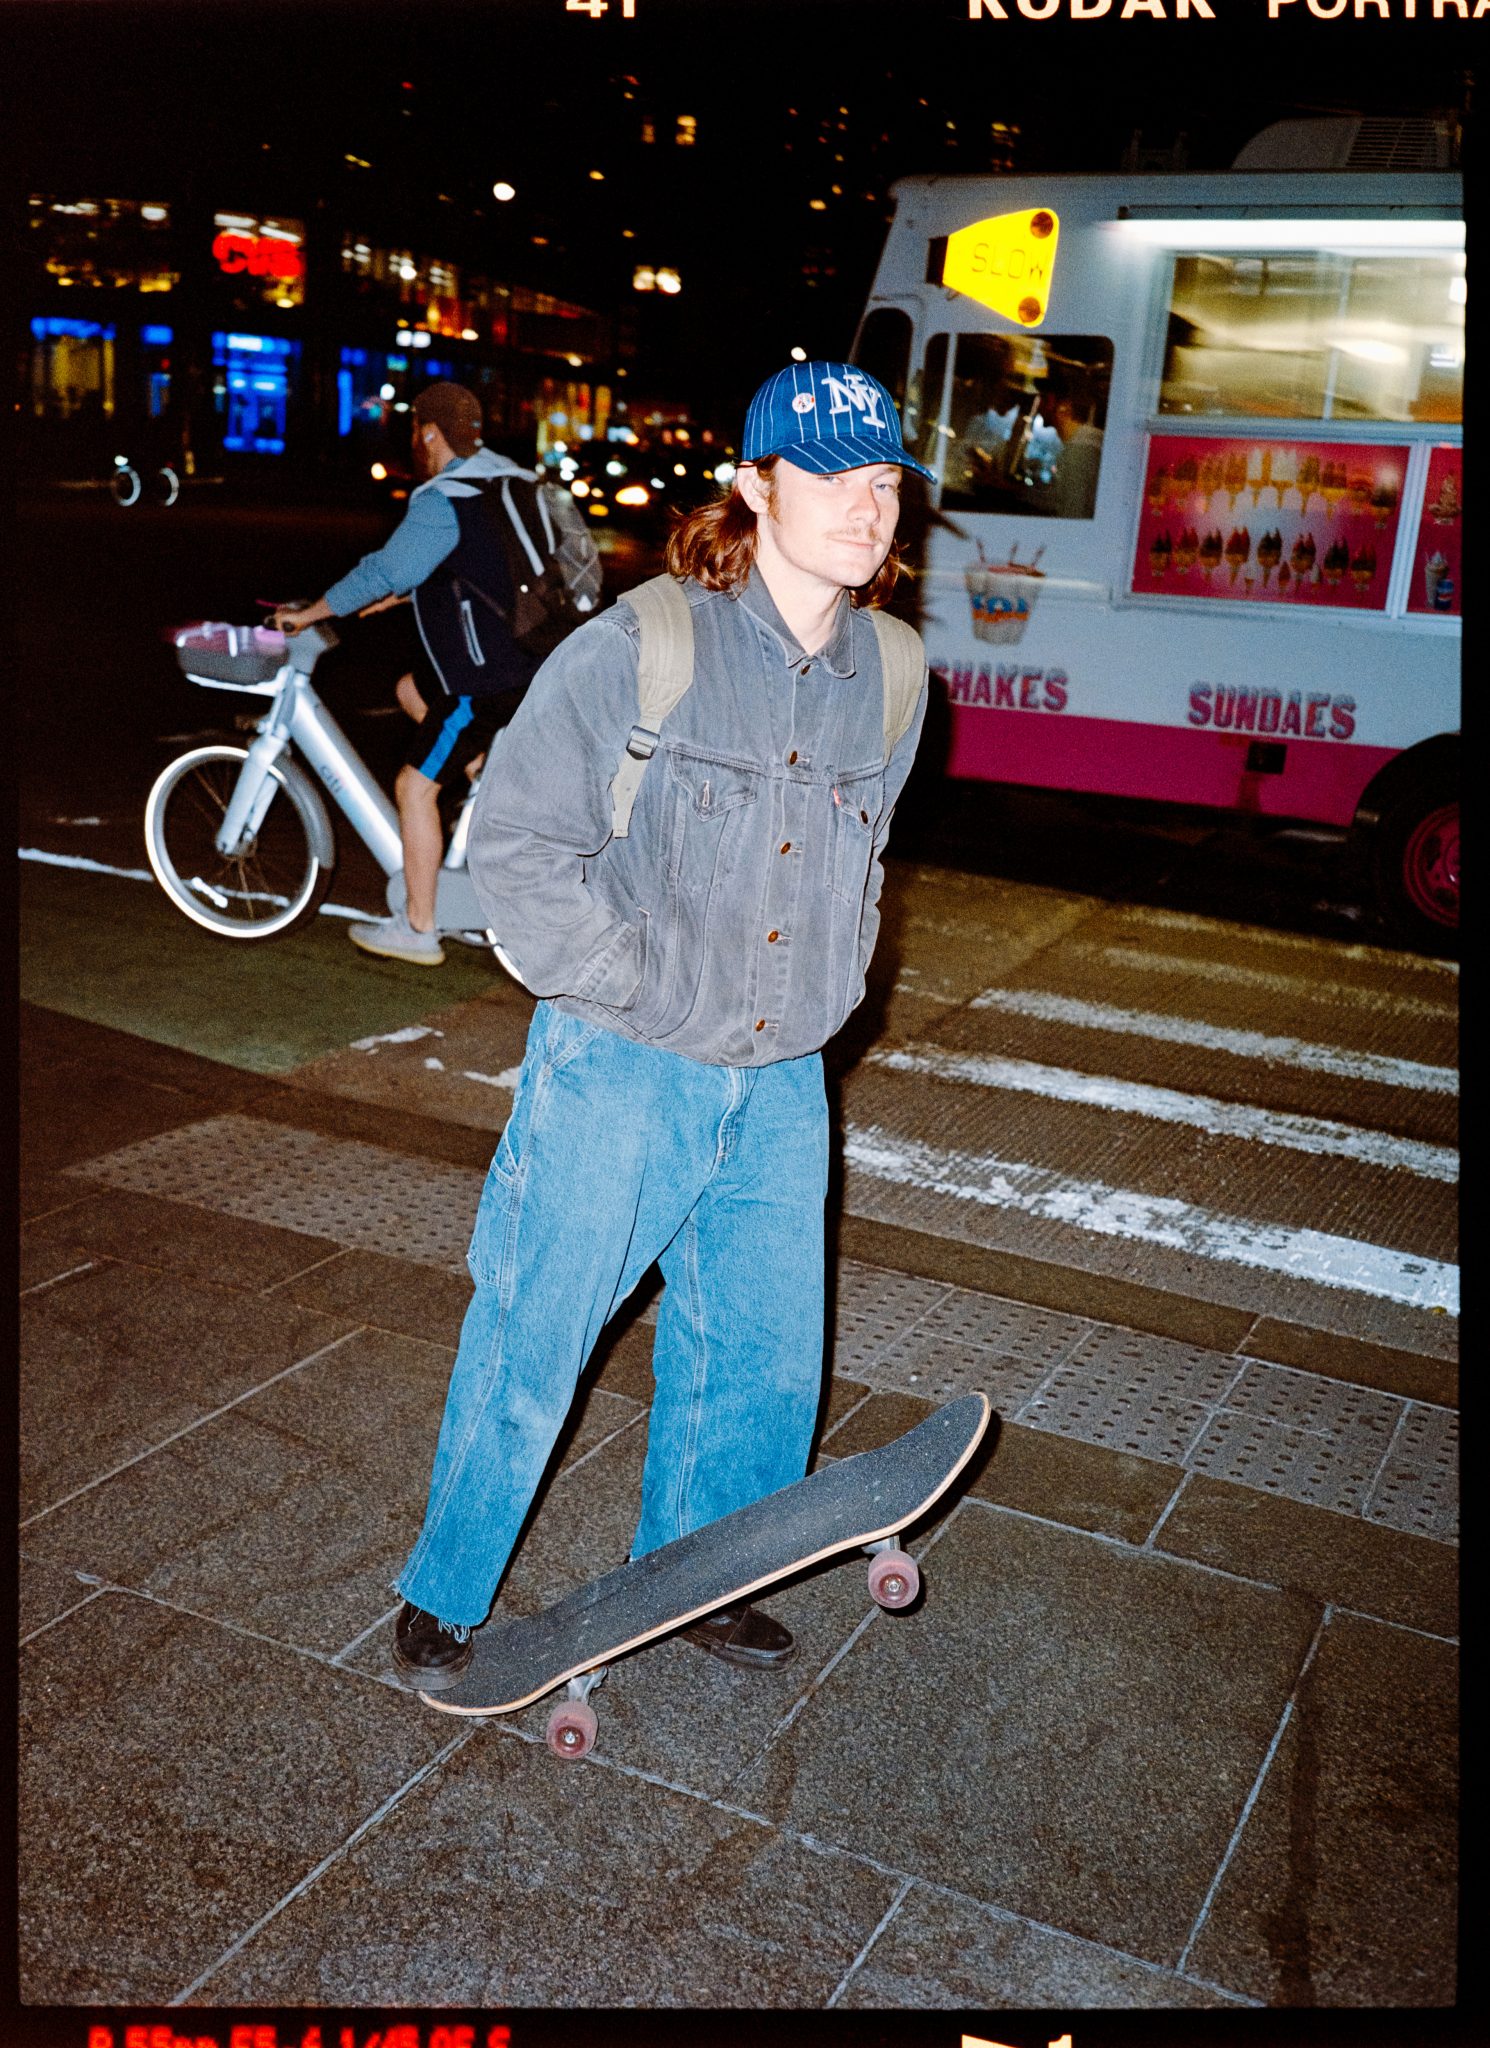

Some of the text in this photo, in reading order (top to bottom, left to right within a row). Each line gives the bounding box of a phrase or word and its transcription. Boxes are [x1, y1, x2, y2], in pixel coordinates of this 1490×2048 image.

[971, 242, 1049, 281] SLOW
[821, 374, 886, 429] NY
[931, 659, 1069, 712] HAKES
[1188, 681, 1357, 740] SUNDAES
